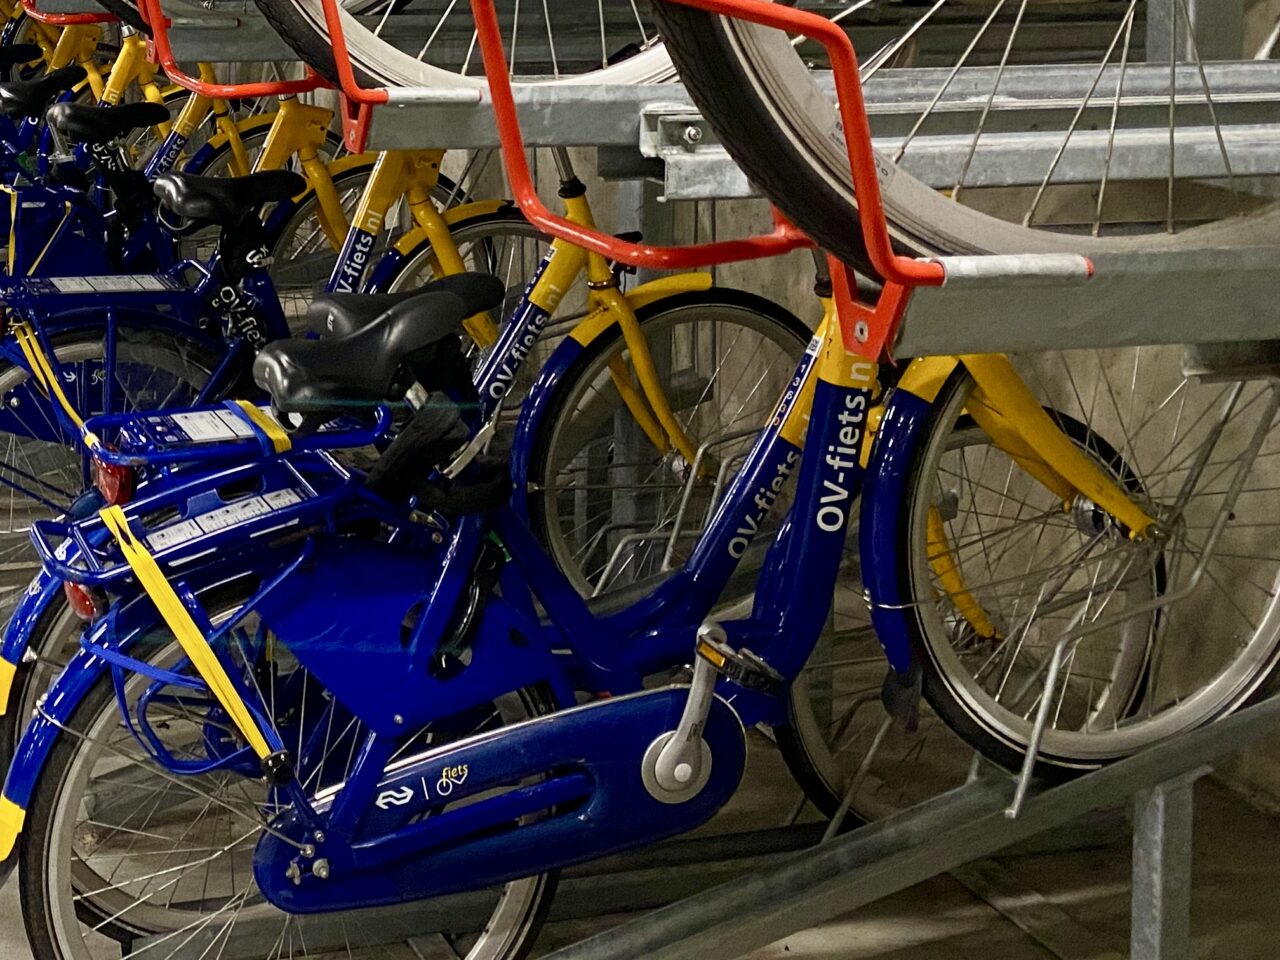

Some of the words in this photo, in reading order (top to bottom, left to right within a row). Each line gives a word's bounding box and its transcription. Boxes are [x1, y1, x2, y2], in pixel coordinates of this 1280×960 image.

[335, 210, 384, 295] V-fiets.nl
[489, 284, 563, 400] OV-fietsnl
[728, 425, 804, 560] OV-fiets
[816, 361, 871, 532] OV-fiets.n
